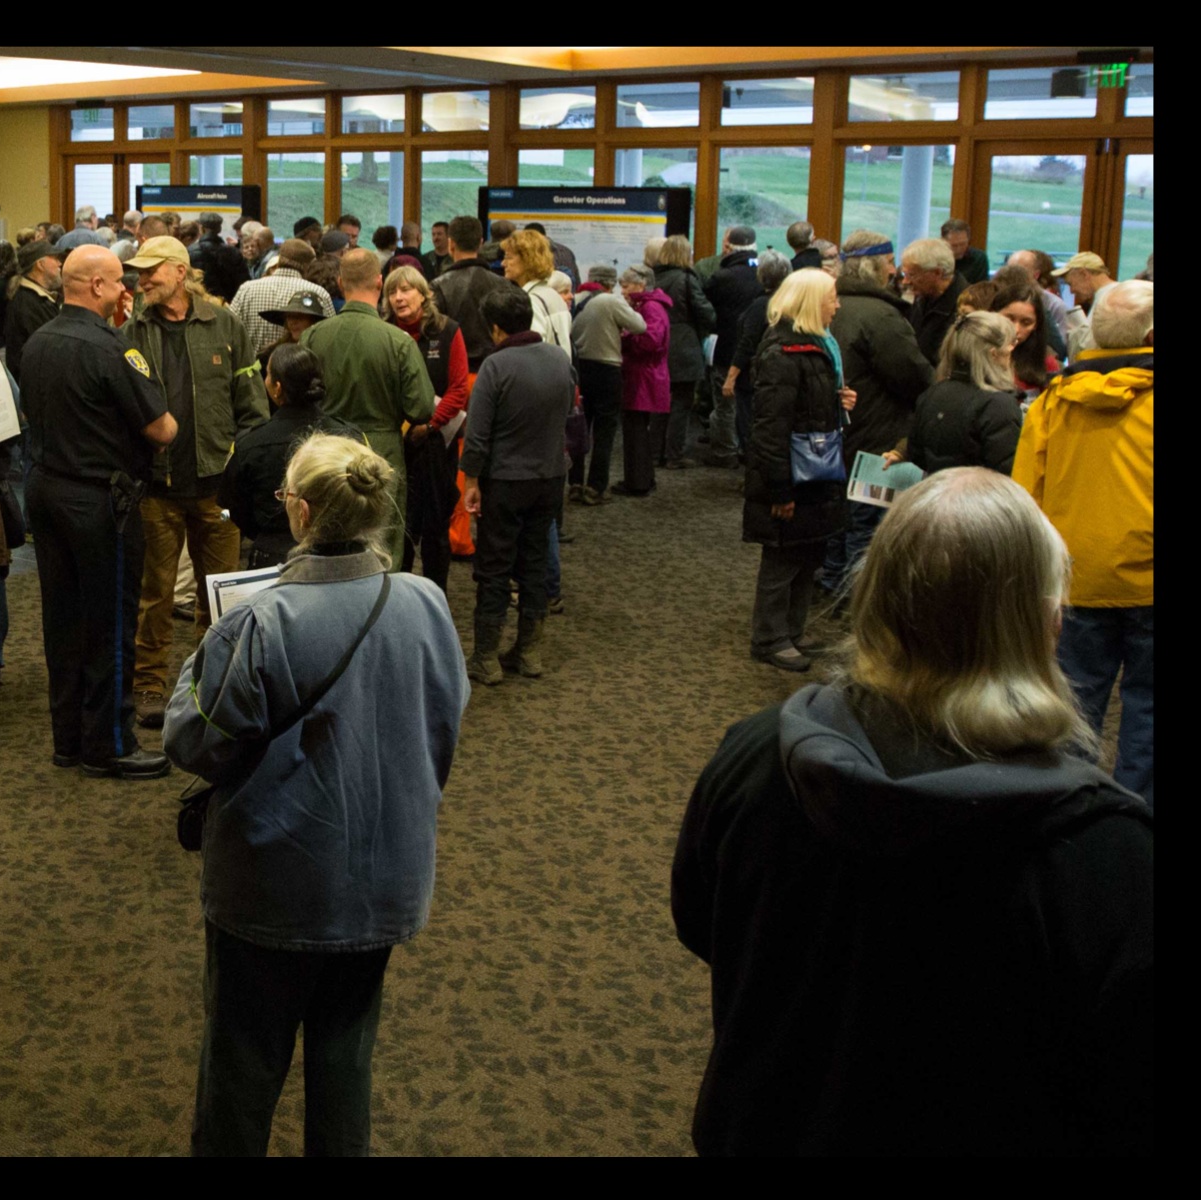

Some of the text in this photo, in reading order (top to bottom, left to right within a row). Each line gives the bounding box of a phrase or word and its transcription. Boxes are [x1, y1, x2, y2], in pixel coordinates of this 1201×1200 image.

[1090, 63, 1128, 87] EXIT
[553, 196, 625, 205] Growler Operations
